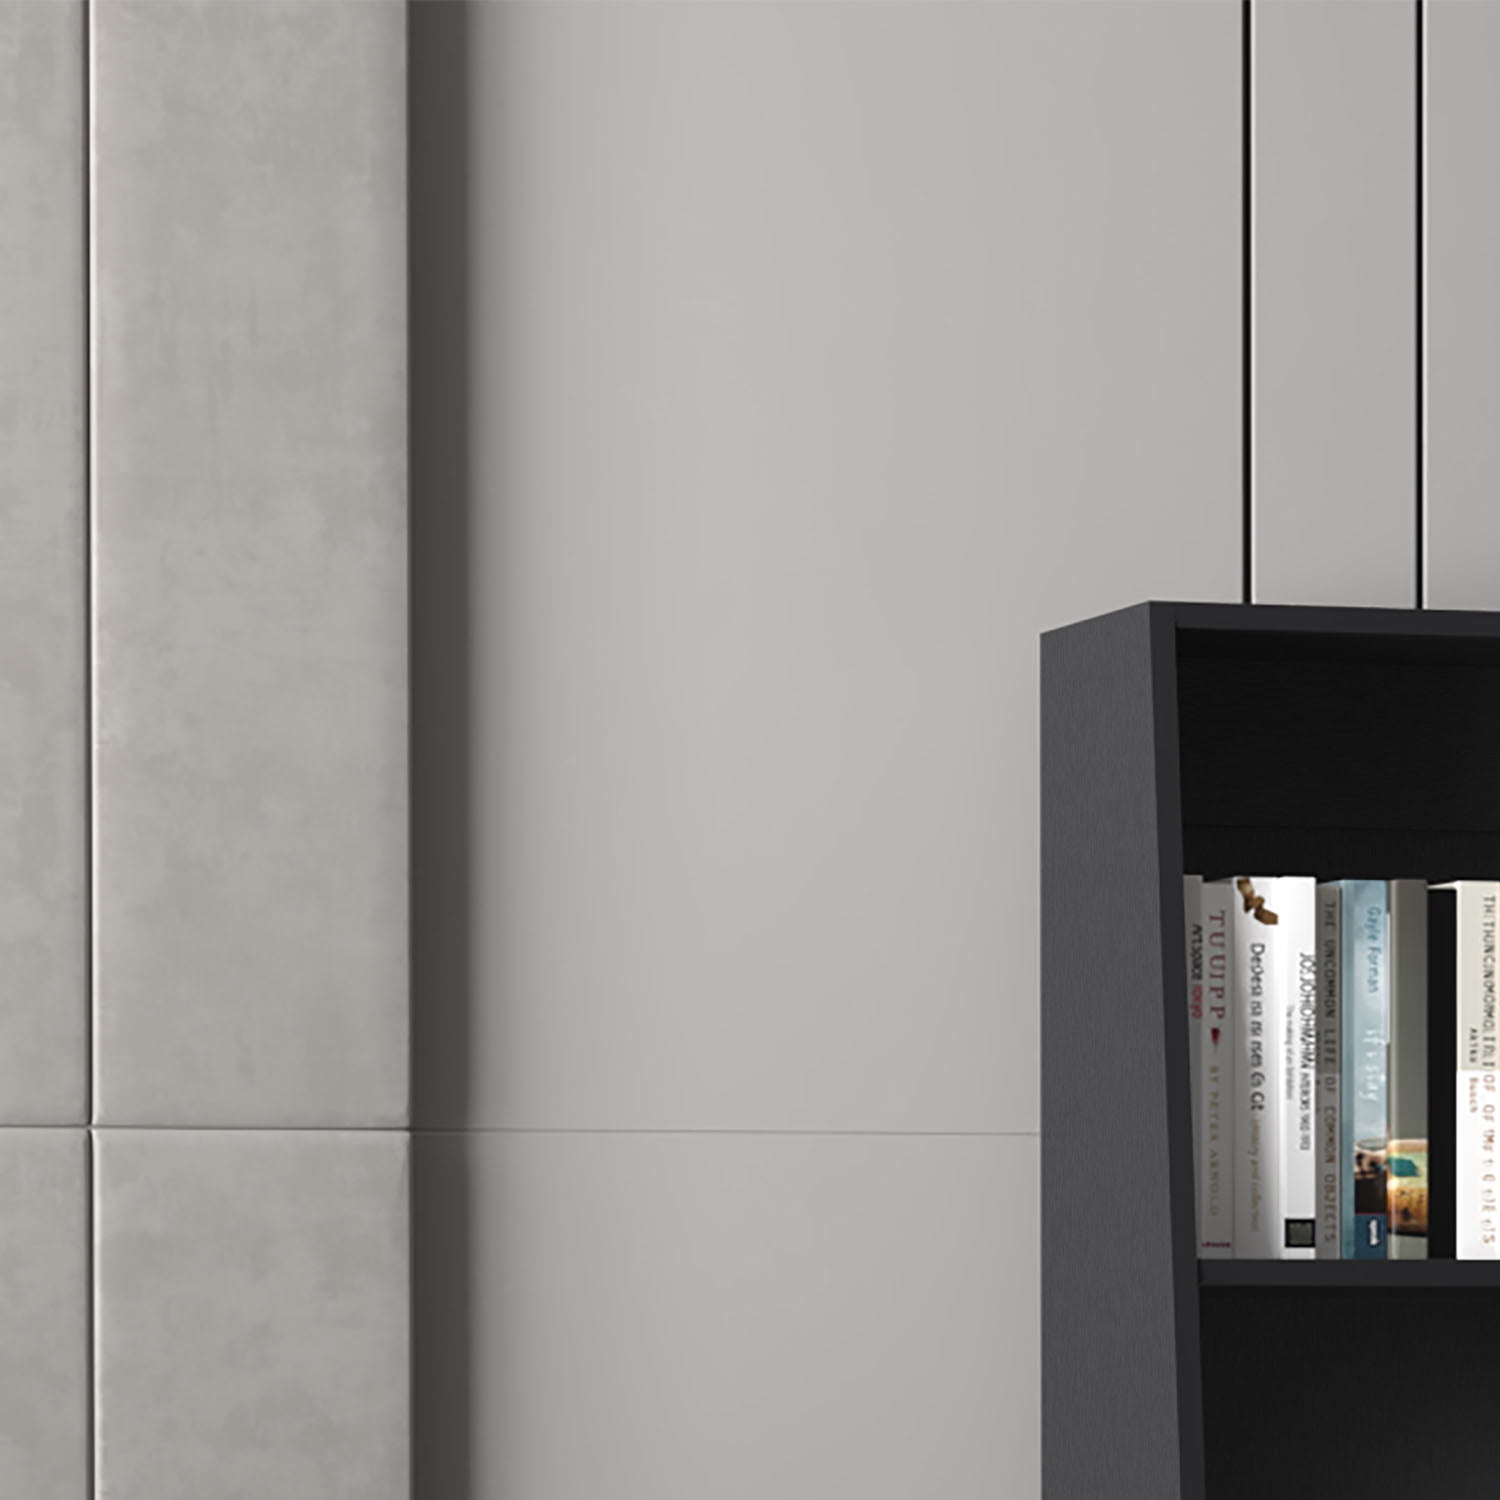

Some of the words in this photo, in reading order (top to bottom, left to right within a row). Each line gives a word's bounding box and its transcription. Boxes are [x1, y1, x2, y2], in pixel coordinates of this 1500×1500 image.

[1324, 902, 1337, 928] THE
[1364, 906, 1382, 941] Gayle
[1324, 939, 1337, 1019] UNCOMMON
[1367, 946, 1382, 993] Forman
[1324, 1030, 1337, 1065] LIFE
[1324, 1076, 1337, 1093] OF
[1324, 1105, 1337, 1164] COMMON
[1324, 1173, 1337, 1244] OBJECTS
